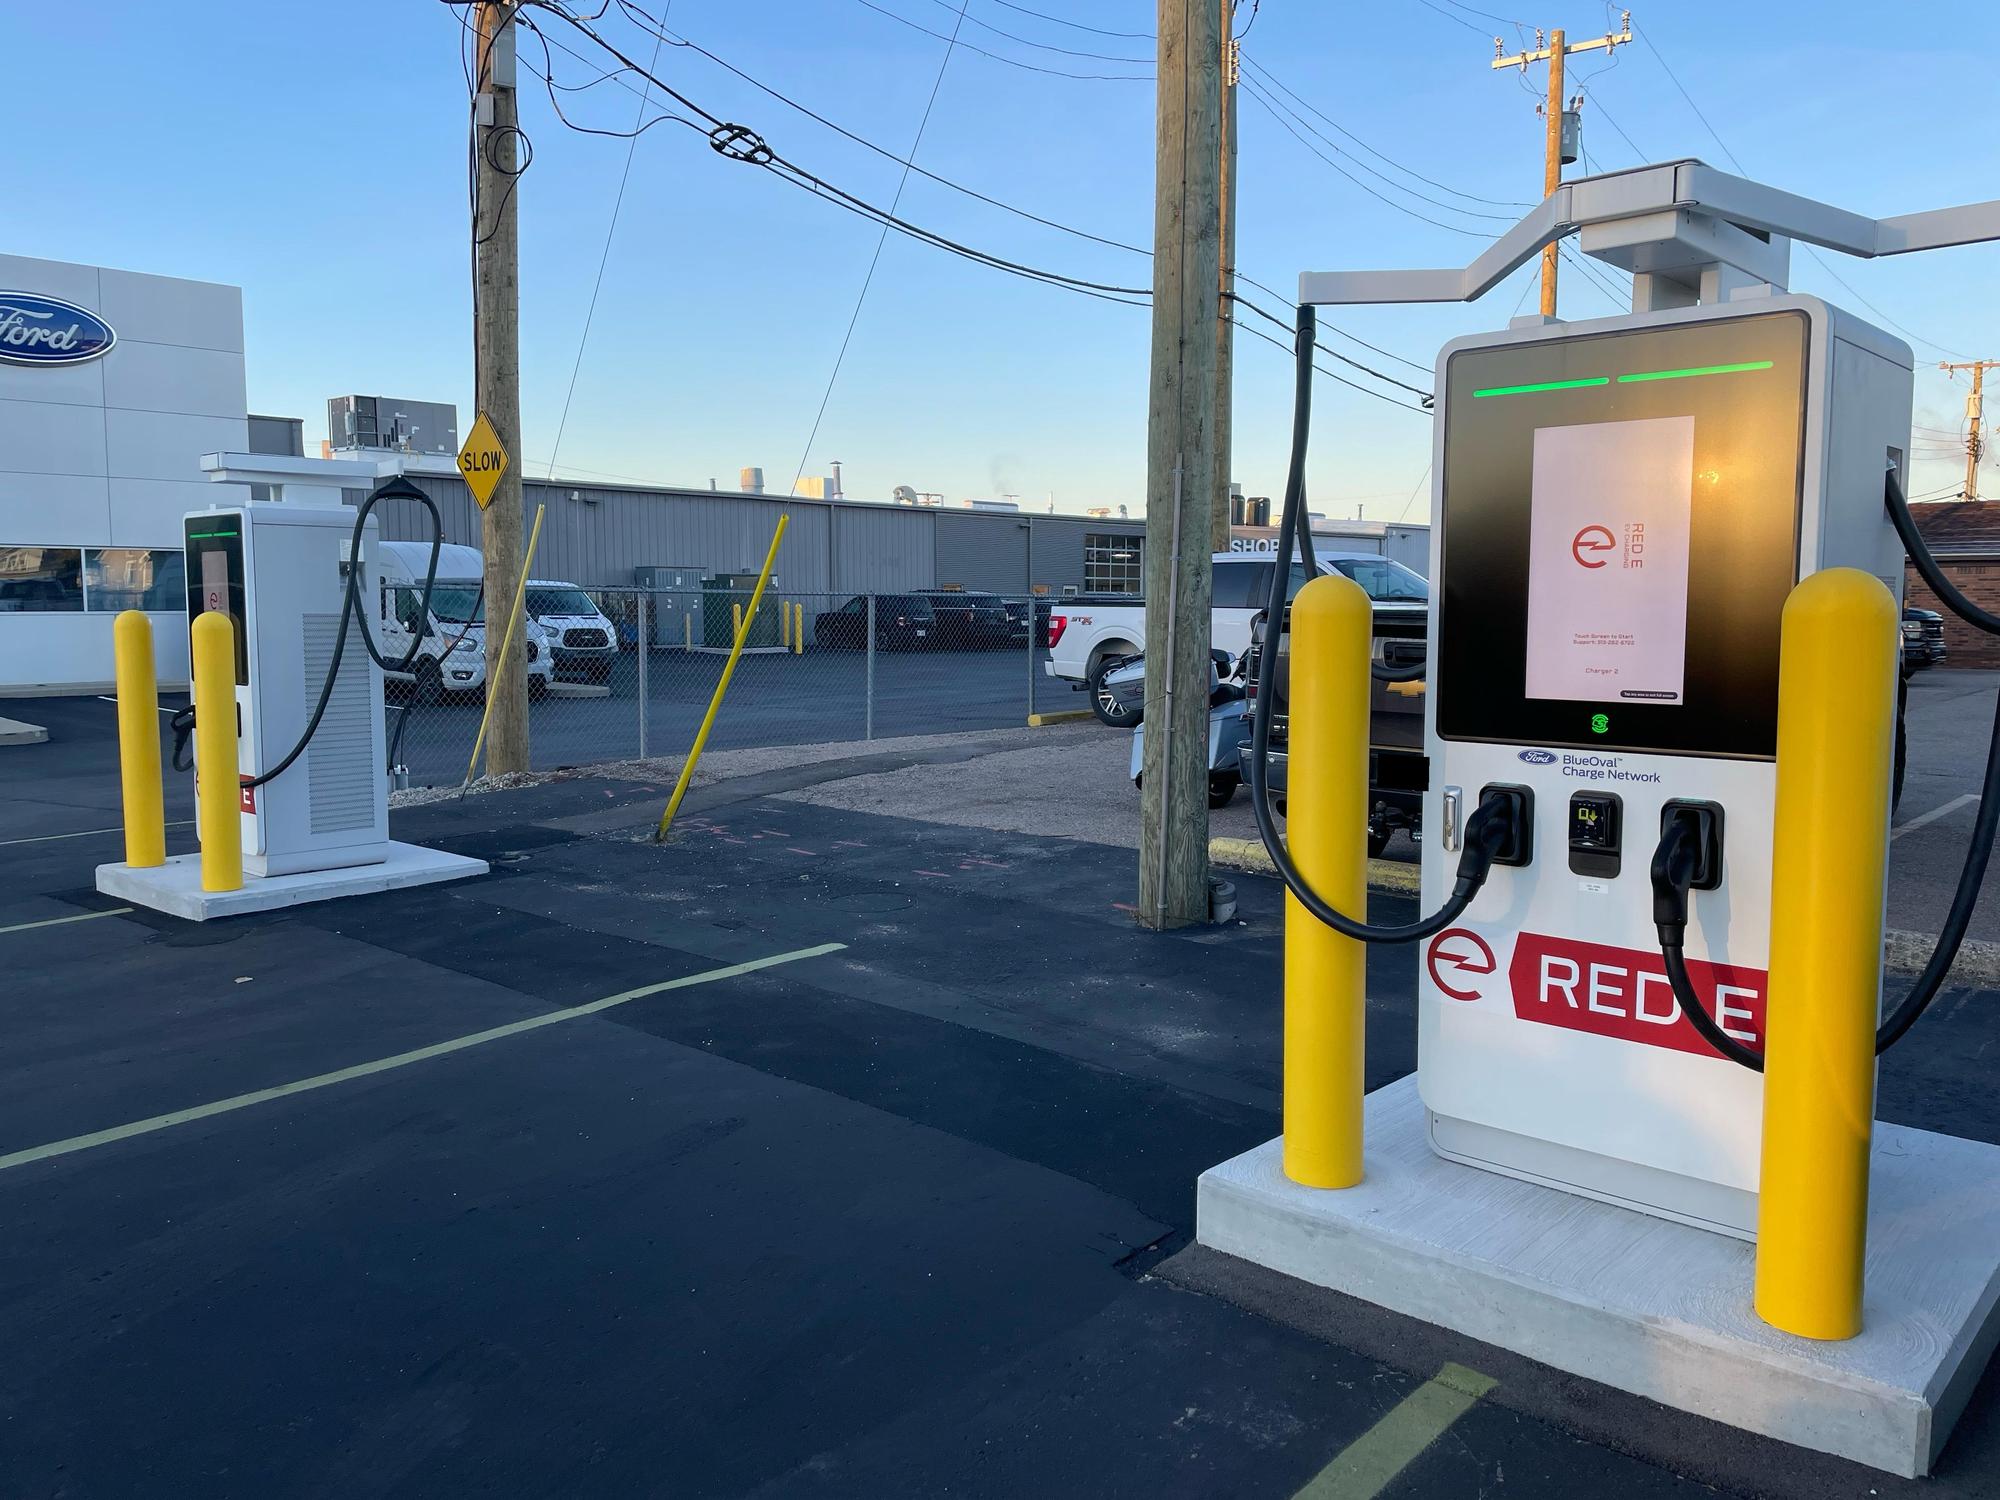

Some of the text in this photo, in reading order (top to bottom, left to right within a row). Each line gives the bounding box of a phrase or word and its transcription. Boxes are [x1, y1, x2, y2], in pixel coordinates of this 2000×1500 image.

[464, 451, 501, 471] SLOW
[1630, 523, 1645, 568] RED E
[1585, 667, 1613, 675] Charger
[1525, 751, 1551, 763] Ford
[1562, 766, 1661, 783] Charge Network
[1539, 954, 1758, 1042] RED E
